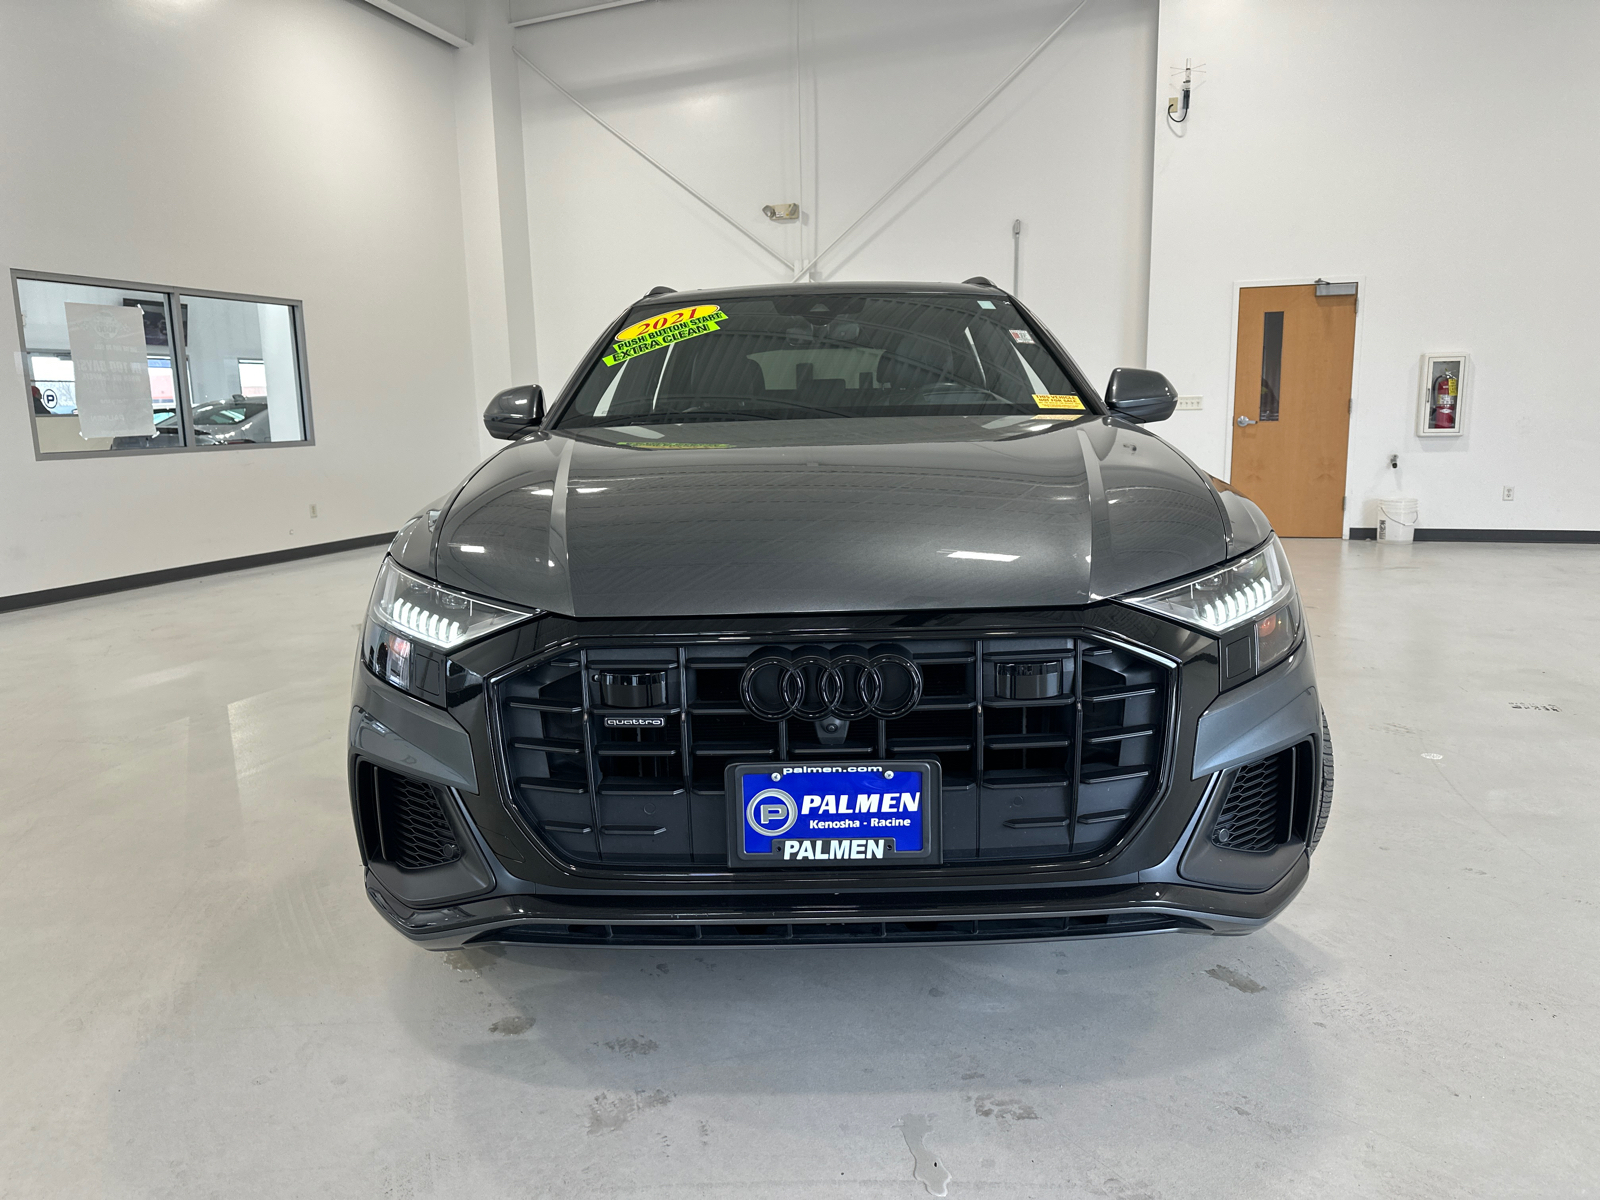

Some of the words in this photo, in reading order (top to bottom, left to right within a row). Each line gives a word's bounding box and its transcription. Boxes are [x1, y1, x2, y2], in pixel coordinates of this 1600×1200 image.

[617, 335, 647, 350] PUSH
[648, 321, 690, 340] BUTTON
[691, 312, 722, 326] START
[636, 308, 697, 336] 2021
[612, 338, 661, 362] EXTRA
[662, 323, 711, 344] CLEAN
[782, 766, 883, 775] palmen.com
[760, 804, 788, 824] P
[801, 791, 921, 815] PALMEN
[809, 819, 860, 829] Kenosha
[870, 818, 911, 827] Racine
[783, 839, 885, 860] PALMEN
